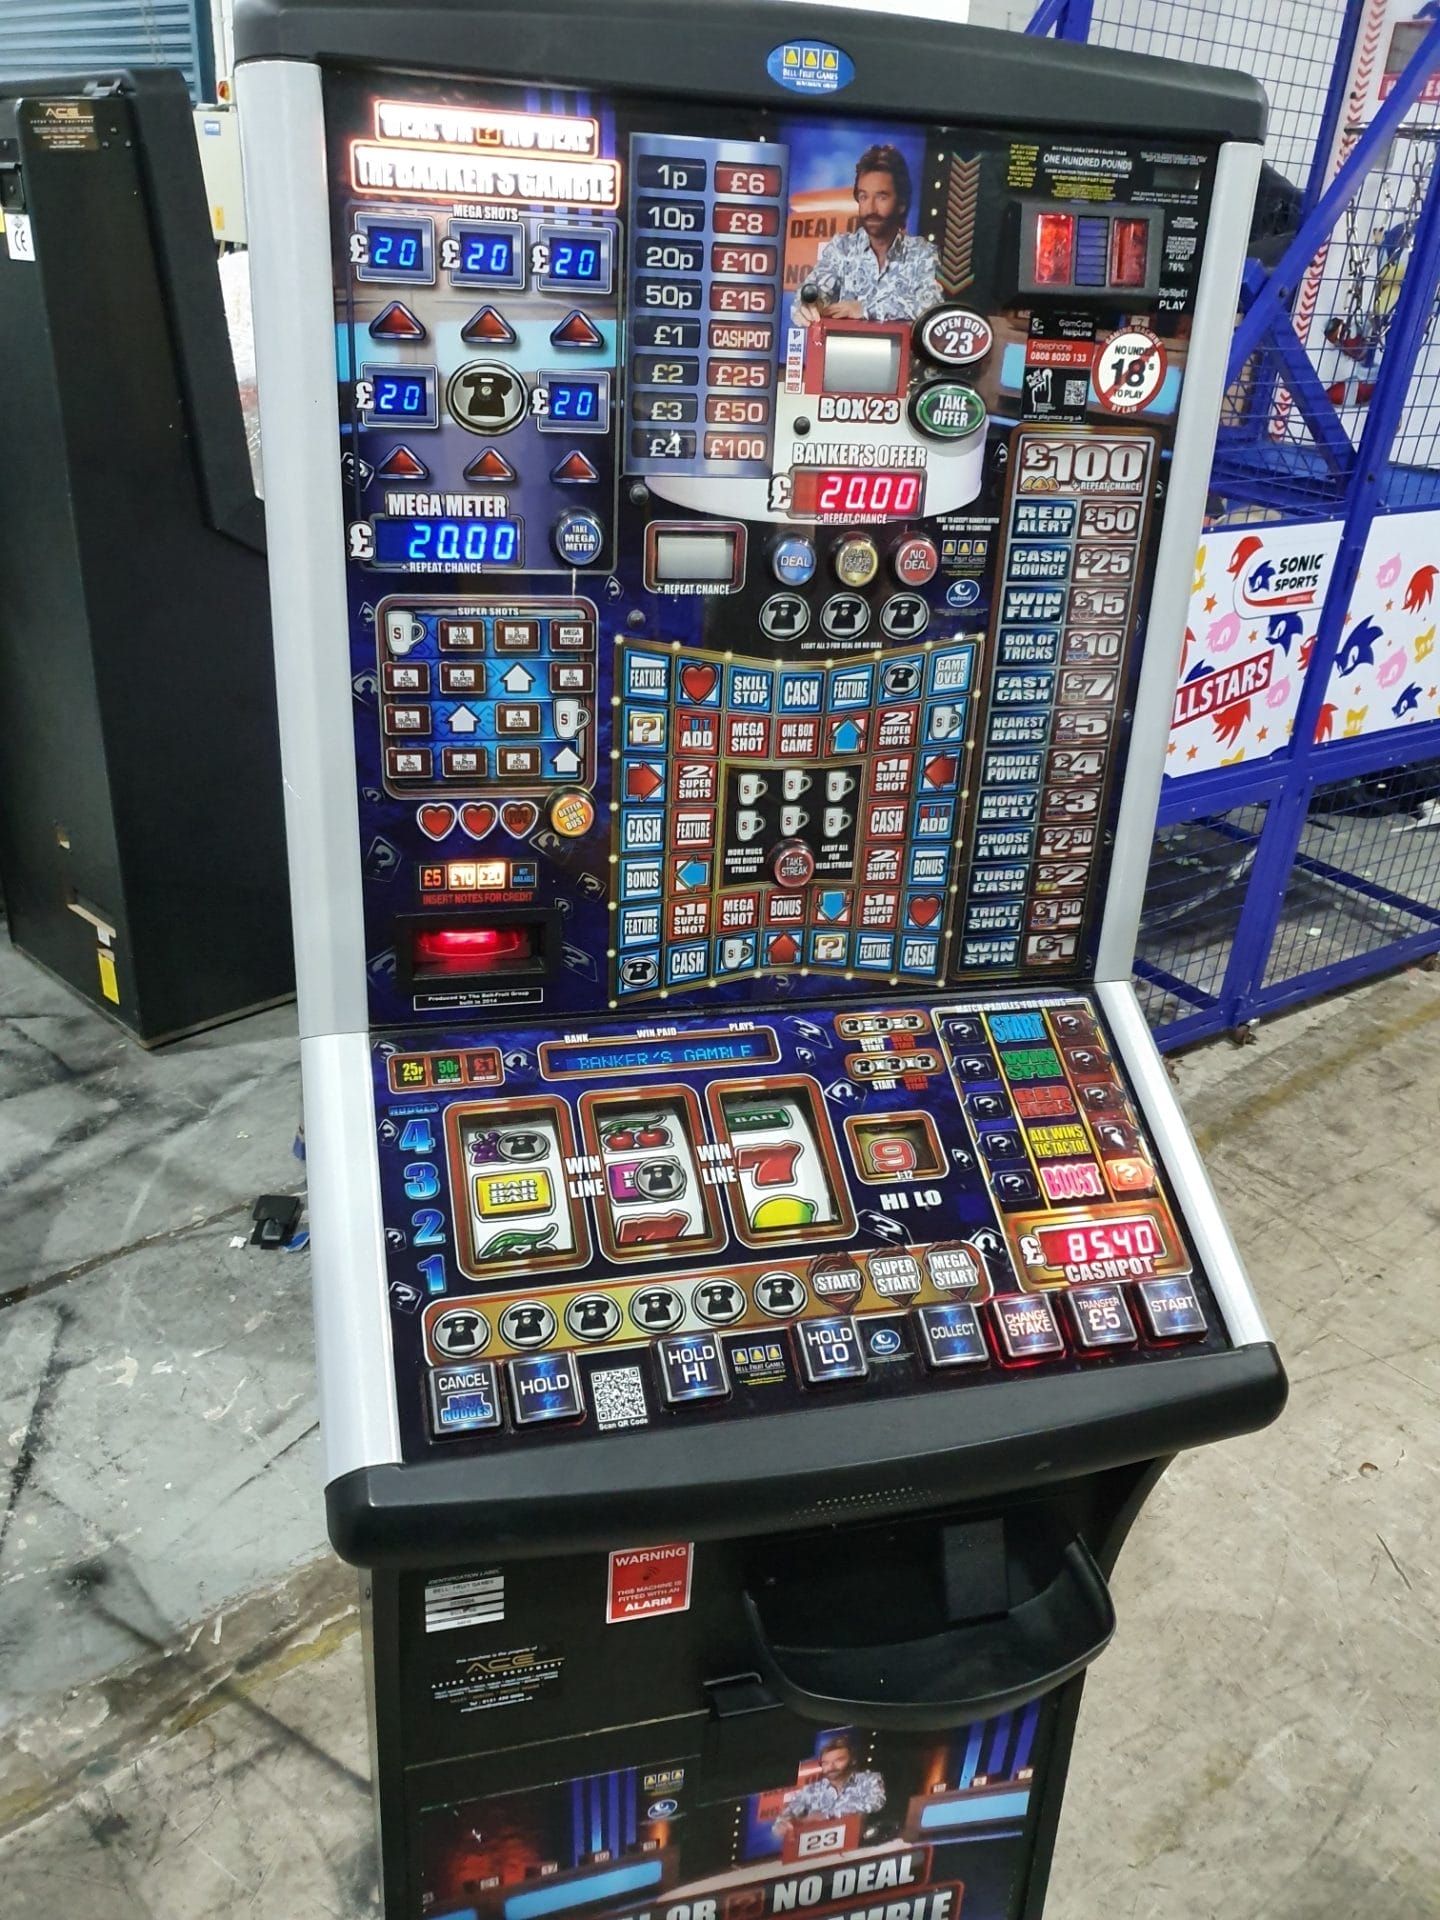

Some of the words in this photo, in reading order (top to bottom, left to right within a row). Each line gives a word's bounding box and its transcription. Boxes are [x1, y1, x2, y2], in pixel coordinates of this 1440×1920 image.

[1043, 153, 1060, 164] ONE
[1062, 156, 1100, 168] HUNDRED
[1101, 159, 1133, 171] POUNDS
[730, 173, 765, 194] £6
[454, 205, 482, 220] MEGA
[483, 206, 518, 220] SHOTS
[648, 206, 695, 231] 10p
[729, 212, 763, 234] £8
[646, 246, 693, 271] 20p
[721, 252, 768, 274] £10
[646, 284, 693, 309] 50p
[720, 290, 766, 312] £15
[1158, 300, 1186, 310] PLAY
[654, 325, 684, 346] £1
[933, 317, 962, 337] OPEN
[963, 317, 987, 339] BOX
[713, 329, 771, 349] CASHPOT
[943, 331, 974, 355] 23
[1114, 345, 1126, 355] NO
[651, 401, 683, 421] £3
[714, 402, 763, 423] £50
[819, 398, 867, 420] BOX
[868, 399, 900, 421] 23
[710, 439, 765, 460] £100
[792, 444, 875, 467] BANKER'S
[876, 445, 927, 468] OFFER
[1025, 444, 1144, 482] £100
[1080, 481, 1108, 491] REPEAT
[1110, 482, 1141, 491] CHANCE
[388, 494, 443, 516] MEGA
[445, 496, 507, 518] METER
[1019, 506, 1072, 519] RED
[1017, 520, 1071, 533] ALERT
[1084, 507, 1136, 531] £50
[565, 533, 595, 543] MEGA
[566, 542, 594, 552] METER
[780, 556, 810, 567] DEAL
[904, 560, 931, 570] DEAL
[1013, 550, 1067, 562] CASH
[1079, 551, 1131, 574] £25
[1278, 553, 1324, 575] SONIC
[409, 562, 442, 574] REPEAT
[444, 563, 482, 574] CHANCE
[1011, 564, 1065, 576] BOUNCE
[664, 584, 694, 595] REPEAT
[696, 584, 730, 594] CHANCE
[1274, 574, 1318, 592] SPORTS
[458, 607, 487, 617] SUPER
[489, 608, 519, 617] SHOTS
[1074, 593, 1125, 616] £15
[630, 669, 666, 687] FEATURE
[734, 676, 767, 690] SKILL
[998, 676, 1048, 688] FAST
[733, 691, 767, 704] STOP
[784, 681, 819, 705] CASH
[996, 689, 1050, 701] CASH
[1174, 656, 1270, 723] LLSTARS
[1059, 714, 1108, 736] £5
[781, 739, 813, 752] GAME
[1054, 753, 1103, 775] £4
[875, 781, 906, 792] SHOT
[983, 794, 1035, 807] MONEY
[1050, 790, 1098, 812] £3
[871, 809, 903, 834] CASH
[981, 807, 1034, 819] BELT
[627, 819, 661, 842] CASH
[677, 823, 709, 839] FEATURE
[1044, 829, 1093, 851] £2.50
[424, 869, 441, 887] £5
[627, 871, 659, 889] BONUS
[423, 895, 453, 905] INSERT
[455, 893, 483, 904] NOTES
[485, 893, 502, 902] FOR
[503, 892, 533, 902] CREDIT
[723, 899, 754, 912] MEGA
[625, 918, 657, 934] FEATURE
[723, 912, 754, 925] SHOT
[863, 915, 892, 925] SHOT
[968, 917, 1020, 929] SHOT
[904, 945, 935, 966] CASH
[964, 941, 1016, 953] WIN
[672, 952, 704, 973] CASH
[563, 1034, 590, 1044] BANK
[1002, 1049, 1057, 1063] WIN
[1006, 1065, 1064, 1080] SPIN
[872, 1079, 896, 1091] START
[399, 1118, 436, 1154] 4
[697, 1143, 732, 1162] WIN
[565, 1156, 601, 1175] WIN
[404, 1161, 440, 1200] 3
[702, 1166, 738, 1185] LINE
[1043, 1164, 1104, 1199] BOOST
[568, 1178, 605, 1198] LINE
[880, 1192, 909, 1210] HI
[913, 1190, 942, 1206] LO
[411, 1208, 447, 1247] 2
[933, 1253, 968, 1268] MEGA
[1064, 1257, 1154, 1283] CASHPOT
[417, 1253, 447, 1295] 1
[816, 1272, 860, 1292] START
[935, 1268, 975, 1286] START
[1150, 1297, 1194, 1313] START
[1005, 1309, 1048, 1324] CHANGE
[1089, 1308, 1121, 1330] £5
[808, 1328, 853, 1346] HOLD
[1009, 1321, 1052, 1337] STAKE
[668, 1345, 715, 1364] HOLD
[820, 1344, 850, 1364] LO
[438, 1372, 489, 1391] CANCEL
[683, 1364, 708, 1384] HI
[520, 1374, 570, 1396] HOLD
[443, 1406, 492, 1423] NUDGES
[618, 1420, 629, 1428] QR
[615, 1547, 687, 1568] WARNING
[618, 1594, 646, 1603] FITTED
[647, 1588, 667, 1597] WITH
[625, 1597, 672, 1613] ALARM
[466, 1653, 535, 1674] ACE
[807, 1833, 838, 1851] 23
[772, 1876, 823, 1913] NO
[832, 1855, 916, 1900] DEAL
